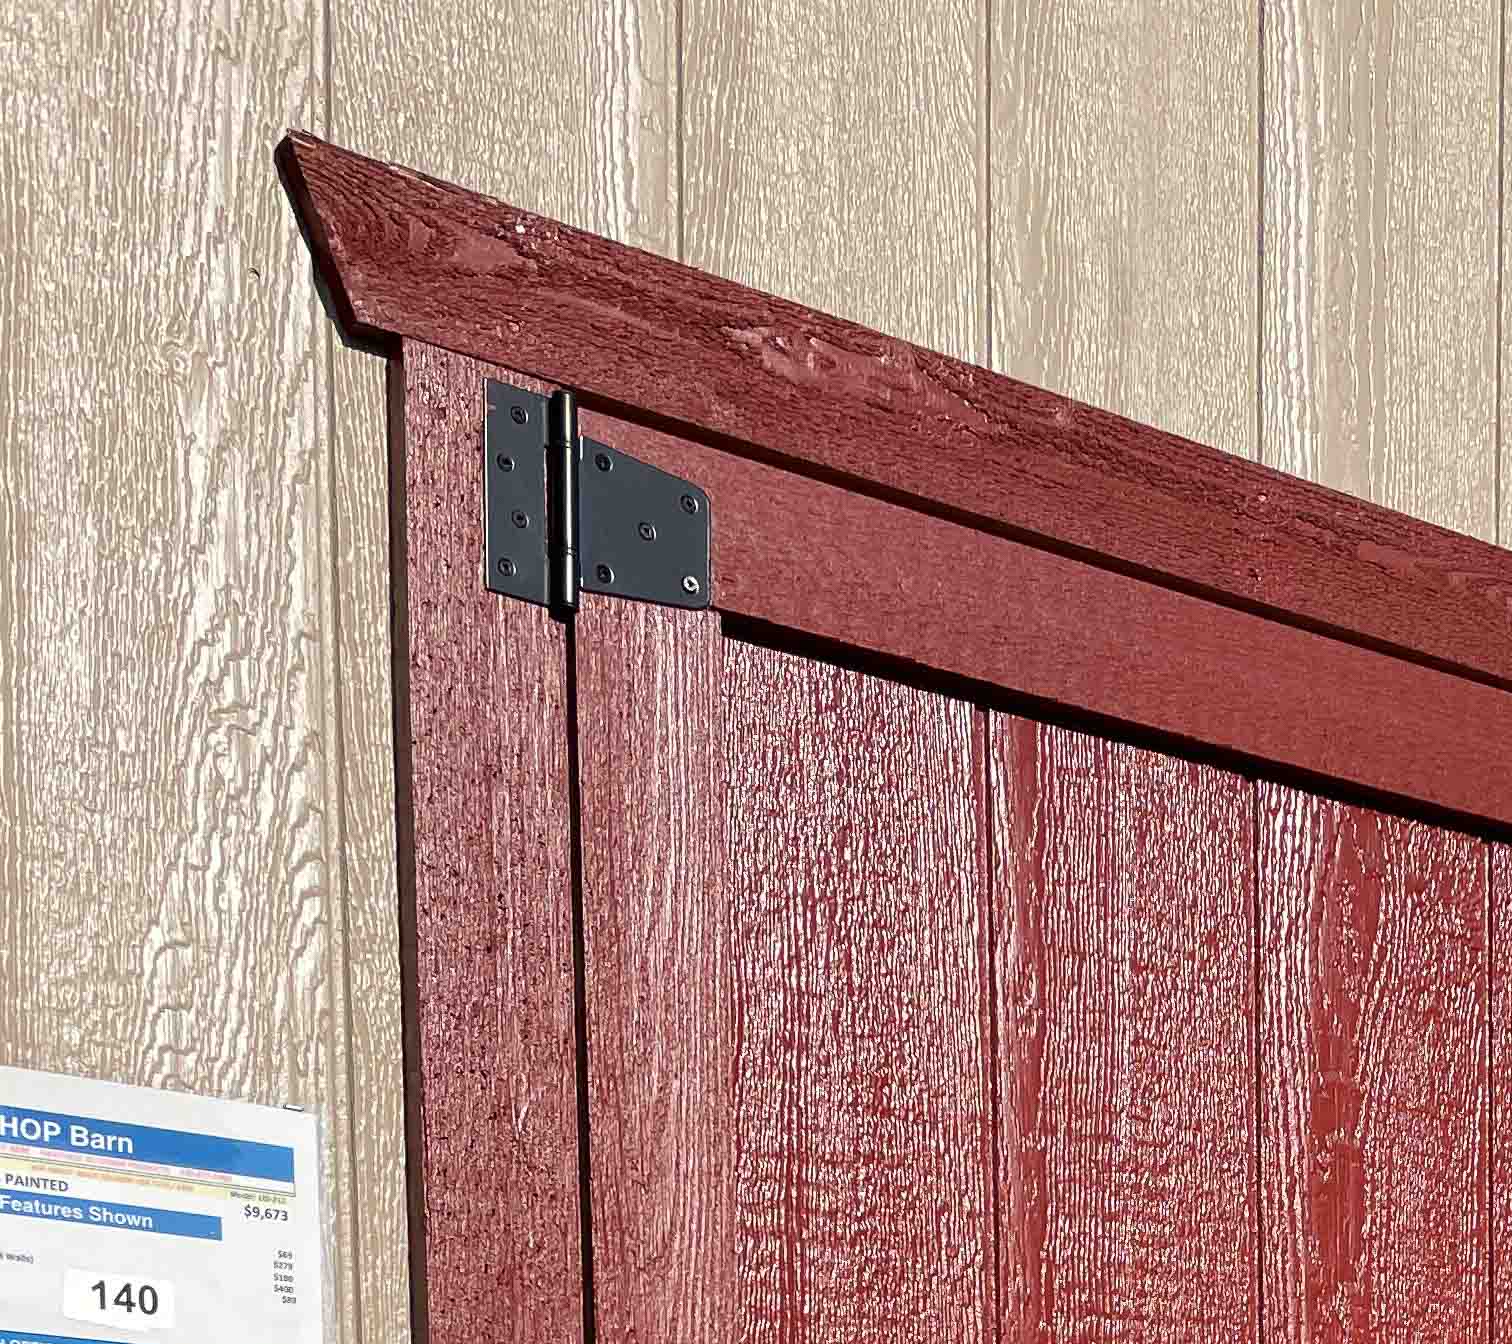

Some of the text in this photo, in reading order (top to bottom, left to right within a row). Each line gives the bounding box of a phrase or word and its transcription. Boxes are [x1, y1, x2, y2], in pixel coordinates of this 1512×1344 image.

[0, 1115, 61, 1142] HOP
[70, 1124, 133, 1154] Barn
[5, 1174, 69, 1192] PAINTED
[0, 1195, 153, 1228] Features Shown
[244, 1204, 288, 1221] $9,673
[91, 1280, 159, 1315] 140
